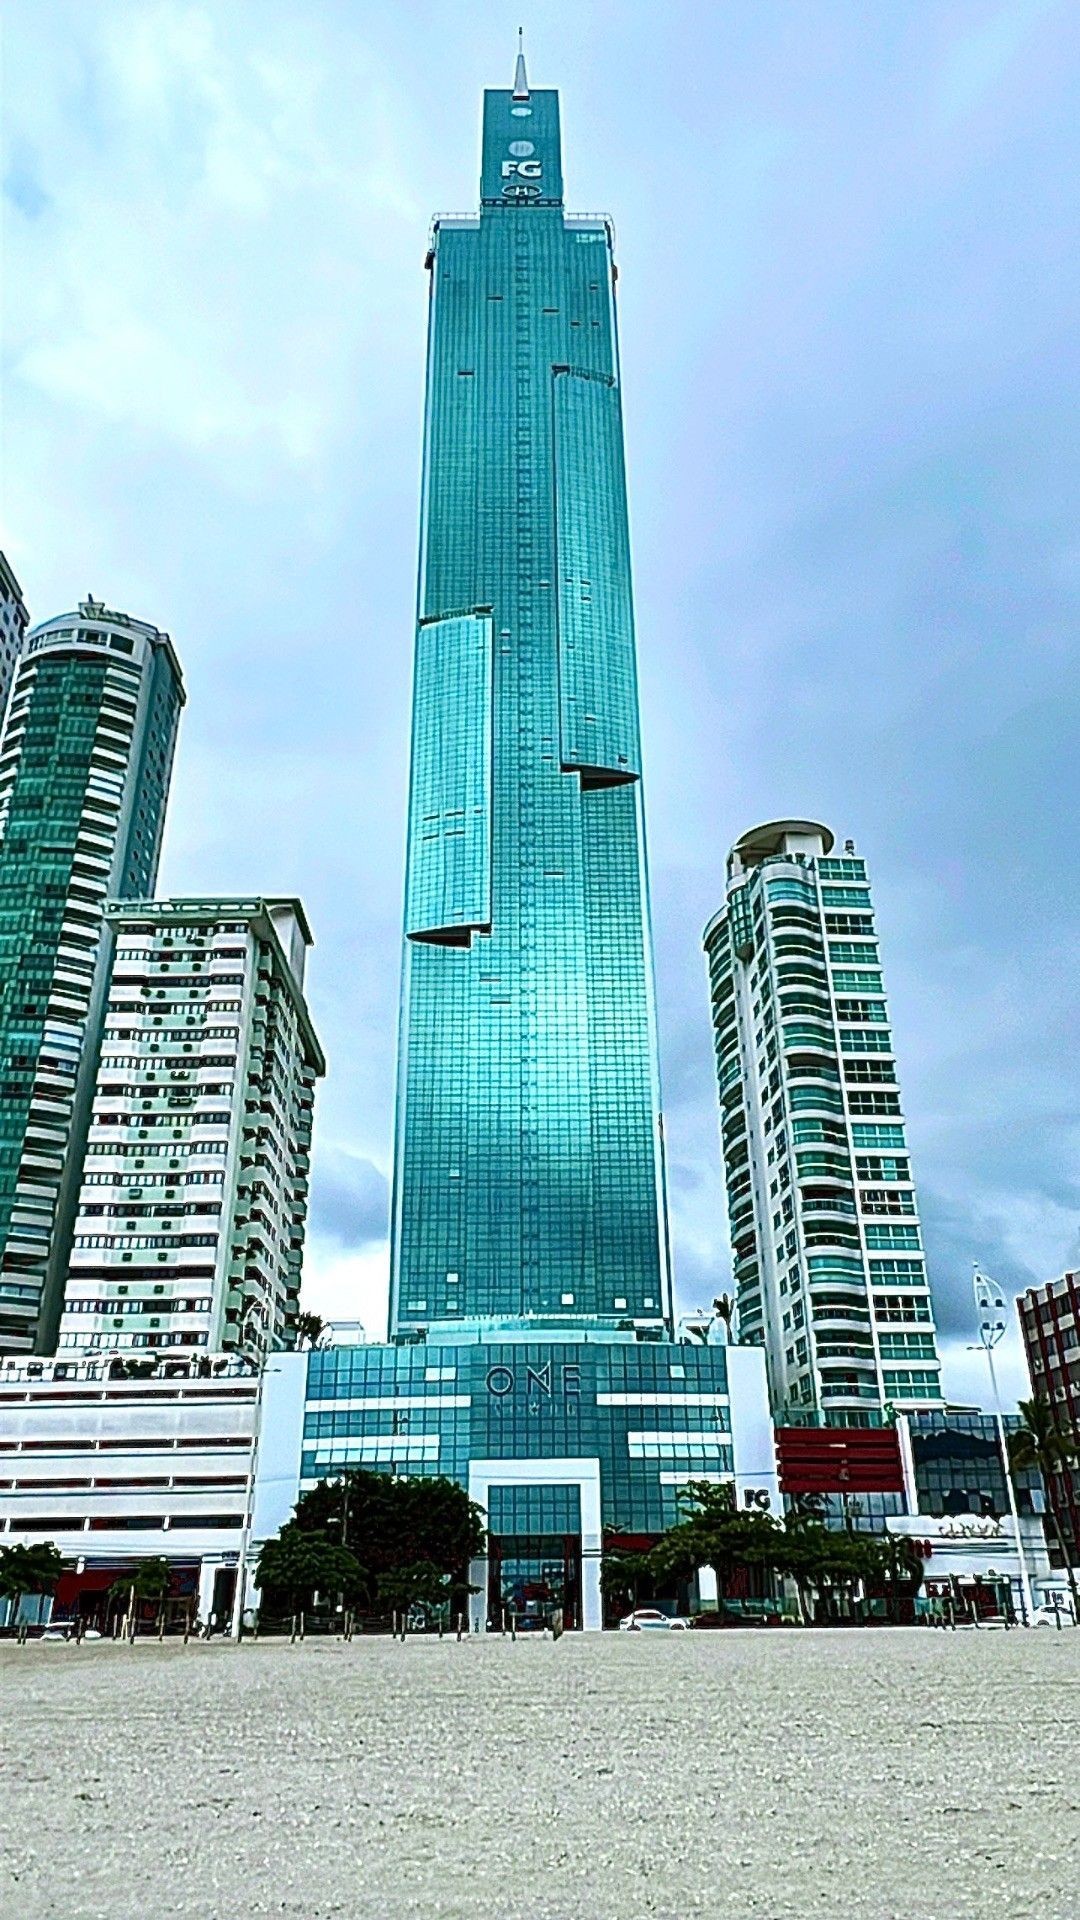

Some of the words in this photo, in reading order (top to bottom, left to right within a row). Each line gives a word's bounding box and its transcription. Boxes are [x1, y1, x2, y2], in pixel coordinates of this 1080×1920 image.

[501, 160, 542, 178] FG
[486, 1360, 580, 1396] ONE
[744, 1489, 770, 1511] FG
